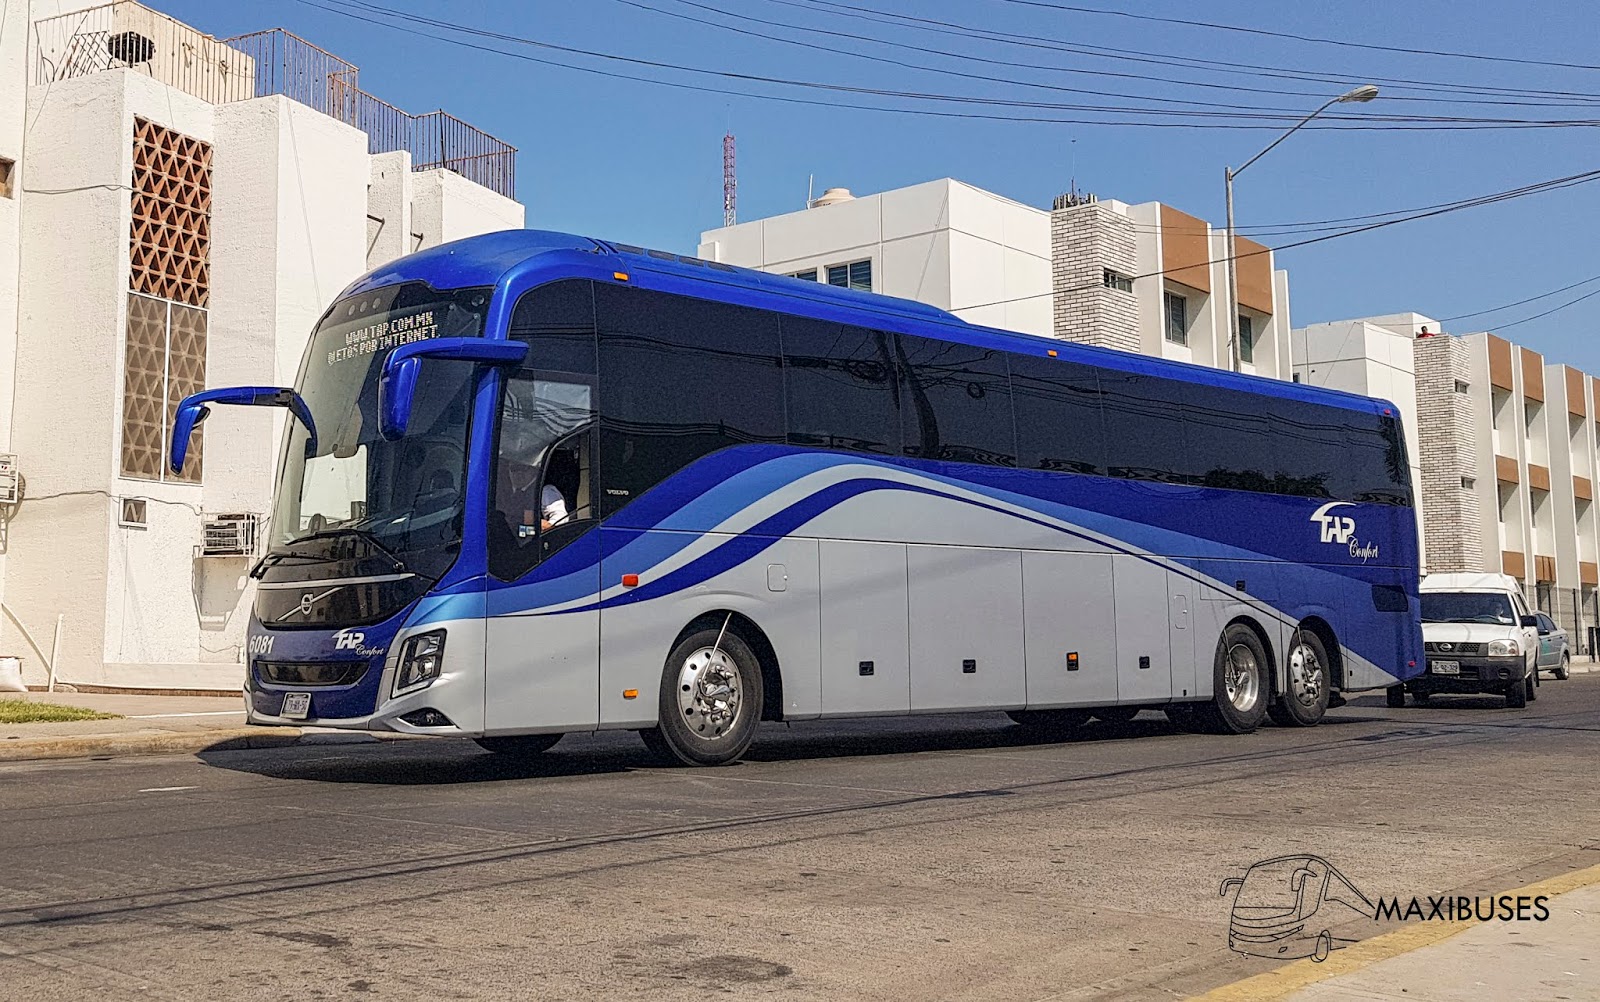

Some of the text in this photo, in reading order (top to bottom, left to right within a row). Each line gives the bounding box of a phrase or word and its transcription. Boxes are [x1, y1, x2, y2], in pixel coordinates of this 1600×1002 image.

[359, 339, 378, 355] POR
[1310, 507, 1356, 544] TAP
[1347, 535, 1378, 564] Confort
[249, 634, 274, 654] 6081
[332, 629, 365, 650] TAP
[355, 643, 384, 657] Confort
